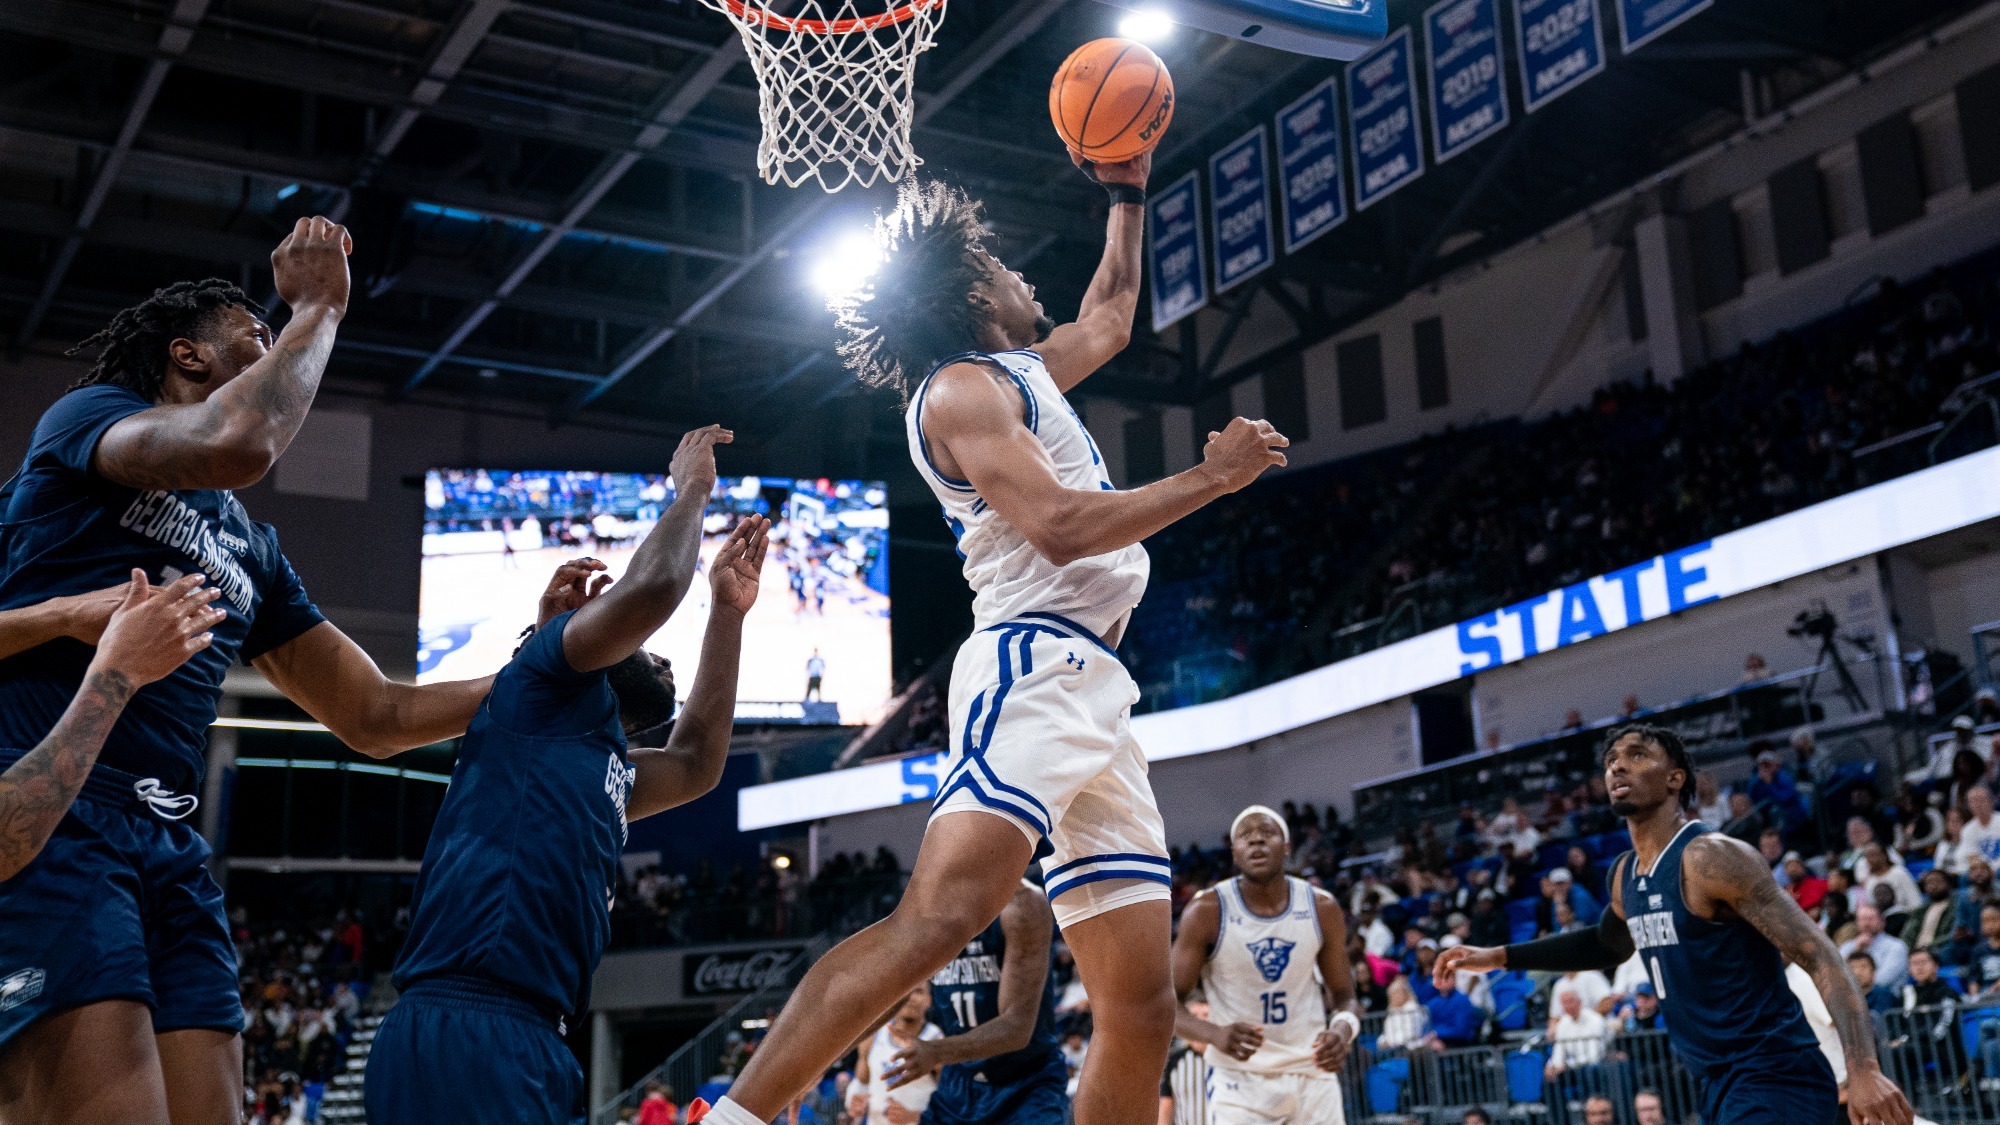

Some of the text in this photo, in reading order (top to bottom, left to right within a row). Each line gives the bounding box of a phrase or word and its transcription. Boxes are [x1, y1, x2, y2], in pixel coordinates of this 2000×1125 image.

[1138, 86, 1172, 141] NCAA
[119, 489, 209, 561] GEORGIA
[1456, 538, 1720, 677] STATE
[1651, 955, 1667, 999] 0
[950, 991, 978, 1027] 11
[1260, 991, 1288, 1024] 15
